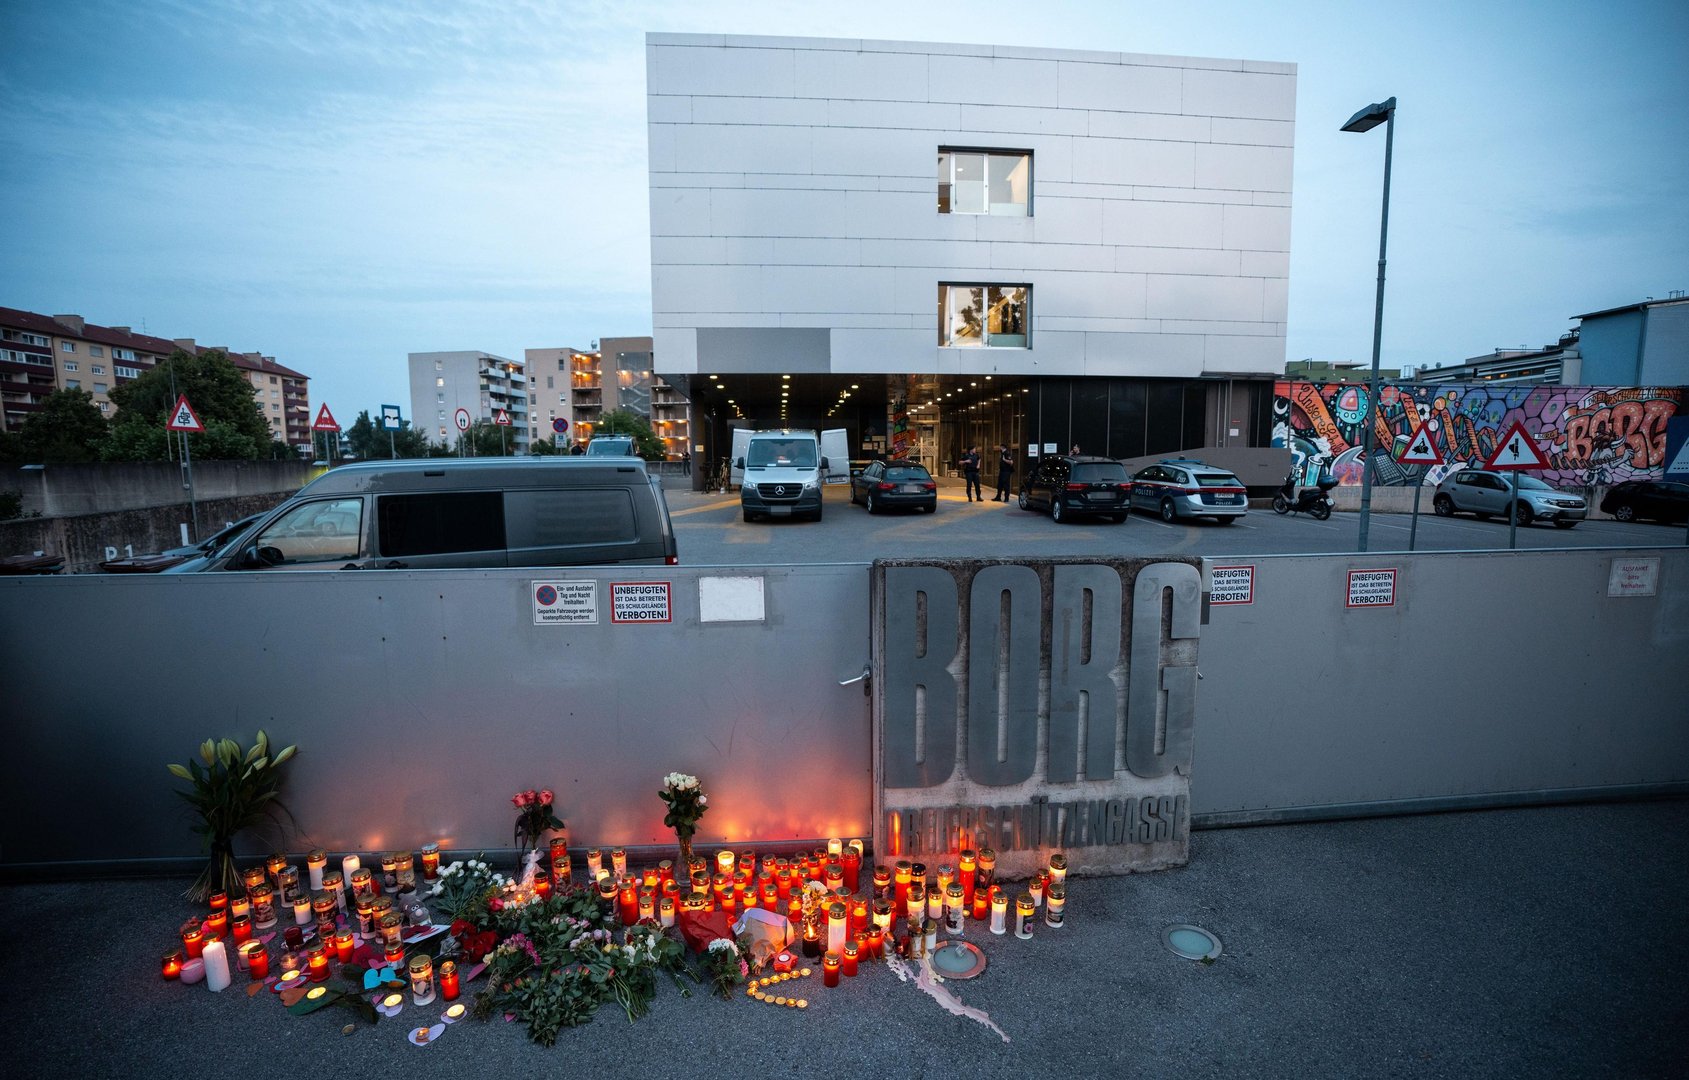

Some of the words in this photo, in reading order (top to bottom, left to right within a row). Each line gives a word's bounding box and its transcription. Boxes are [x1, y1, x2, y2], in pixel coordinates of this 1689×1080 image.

[1562, 400, 1680, 470] BORG
[1135, 488, 1154, 497] POLIZEI
[1212, 570, 1250, 578] NBEFUGTEN
[1351, 573, 1393, 581] UNBEFUGTEN
[614, 586, 666, 594] UNBEFUGTEN
[1210, 593, 1249, 601] ERBOTEN!
[1350, 595, 1391, 604] VERBOTEN!
[616, 610, 667, 619] VERBOTEN!
[885, 562, 1201, 788] BORG
